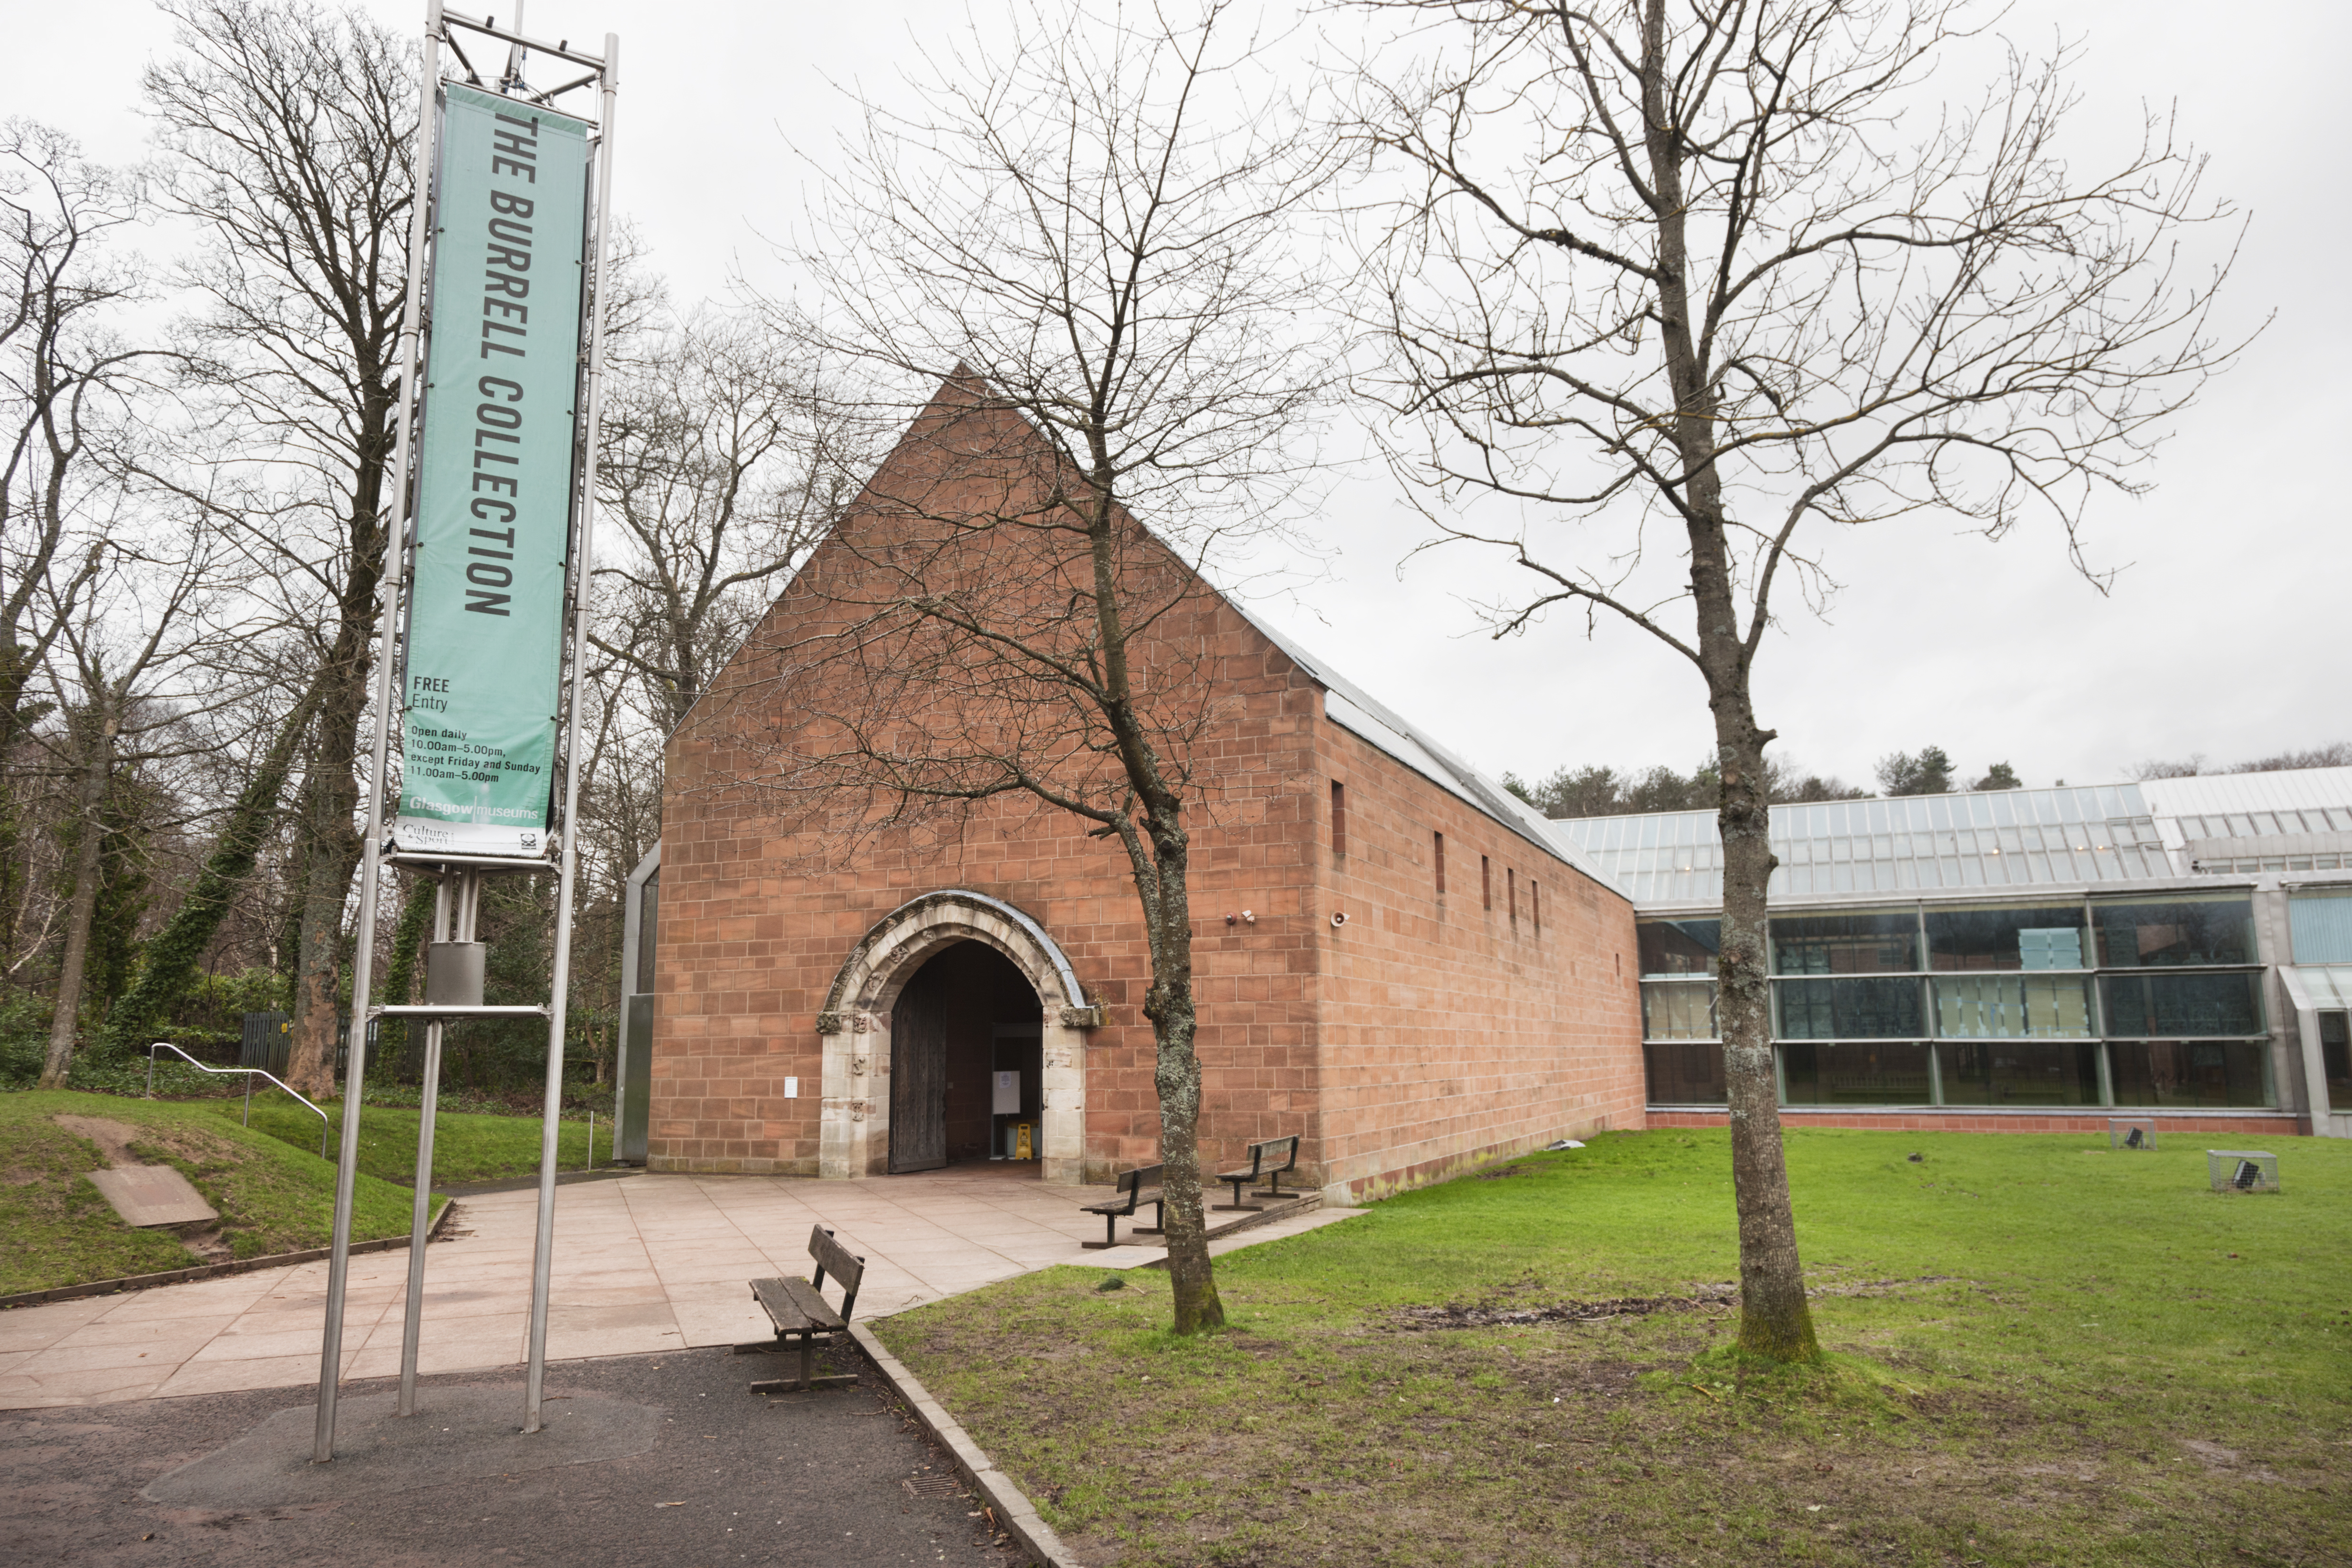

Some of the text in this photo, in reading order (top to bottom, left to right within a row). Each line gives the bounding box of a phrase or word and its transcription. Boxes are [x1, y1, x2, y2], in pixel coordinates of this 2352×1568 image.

[464, 113, 538, 617] THE BURRELL COLLECTION
[414, 676, 450, 693] FREE
[412, 694, 448, 713] Entry
[412, 726, 467, 741] Open daily
[411, 754, 540, 775] except Friday and Sunday
[410, 796, 538, 819] Glasgow museums
[403, 824, 448, 838] Culture
[416, 835, 449, 845] Sport
